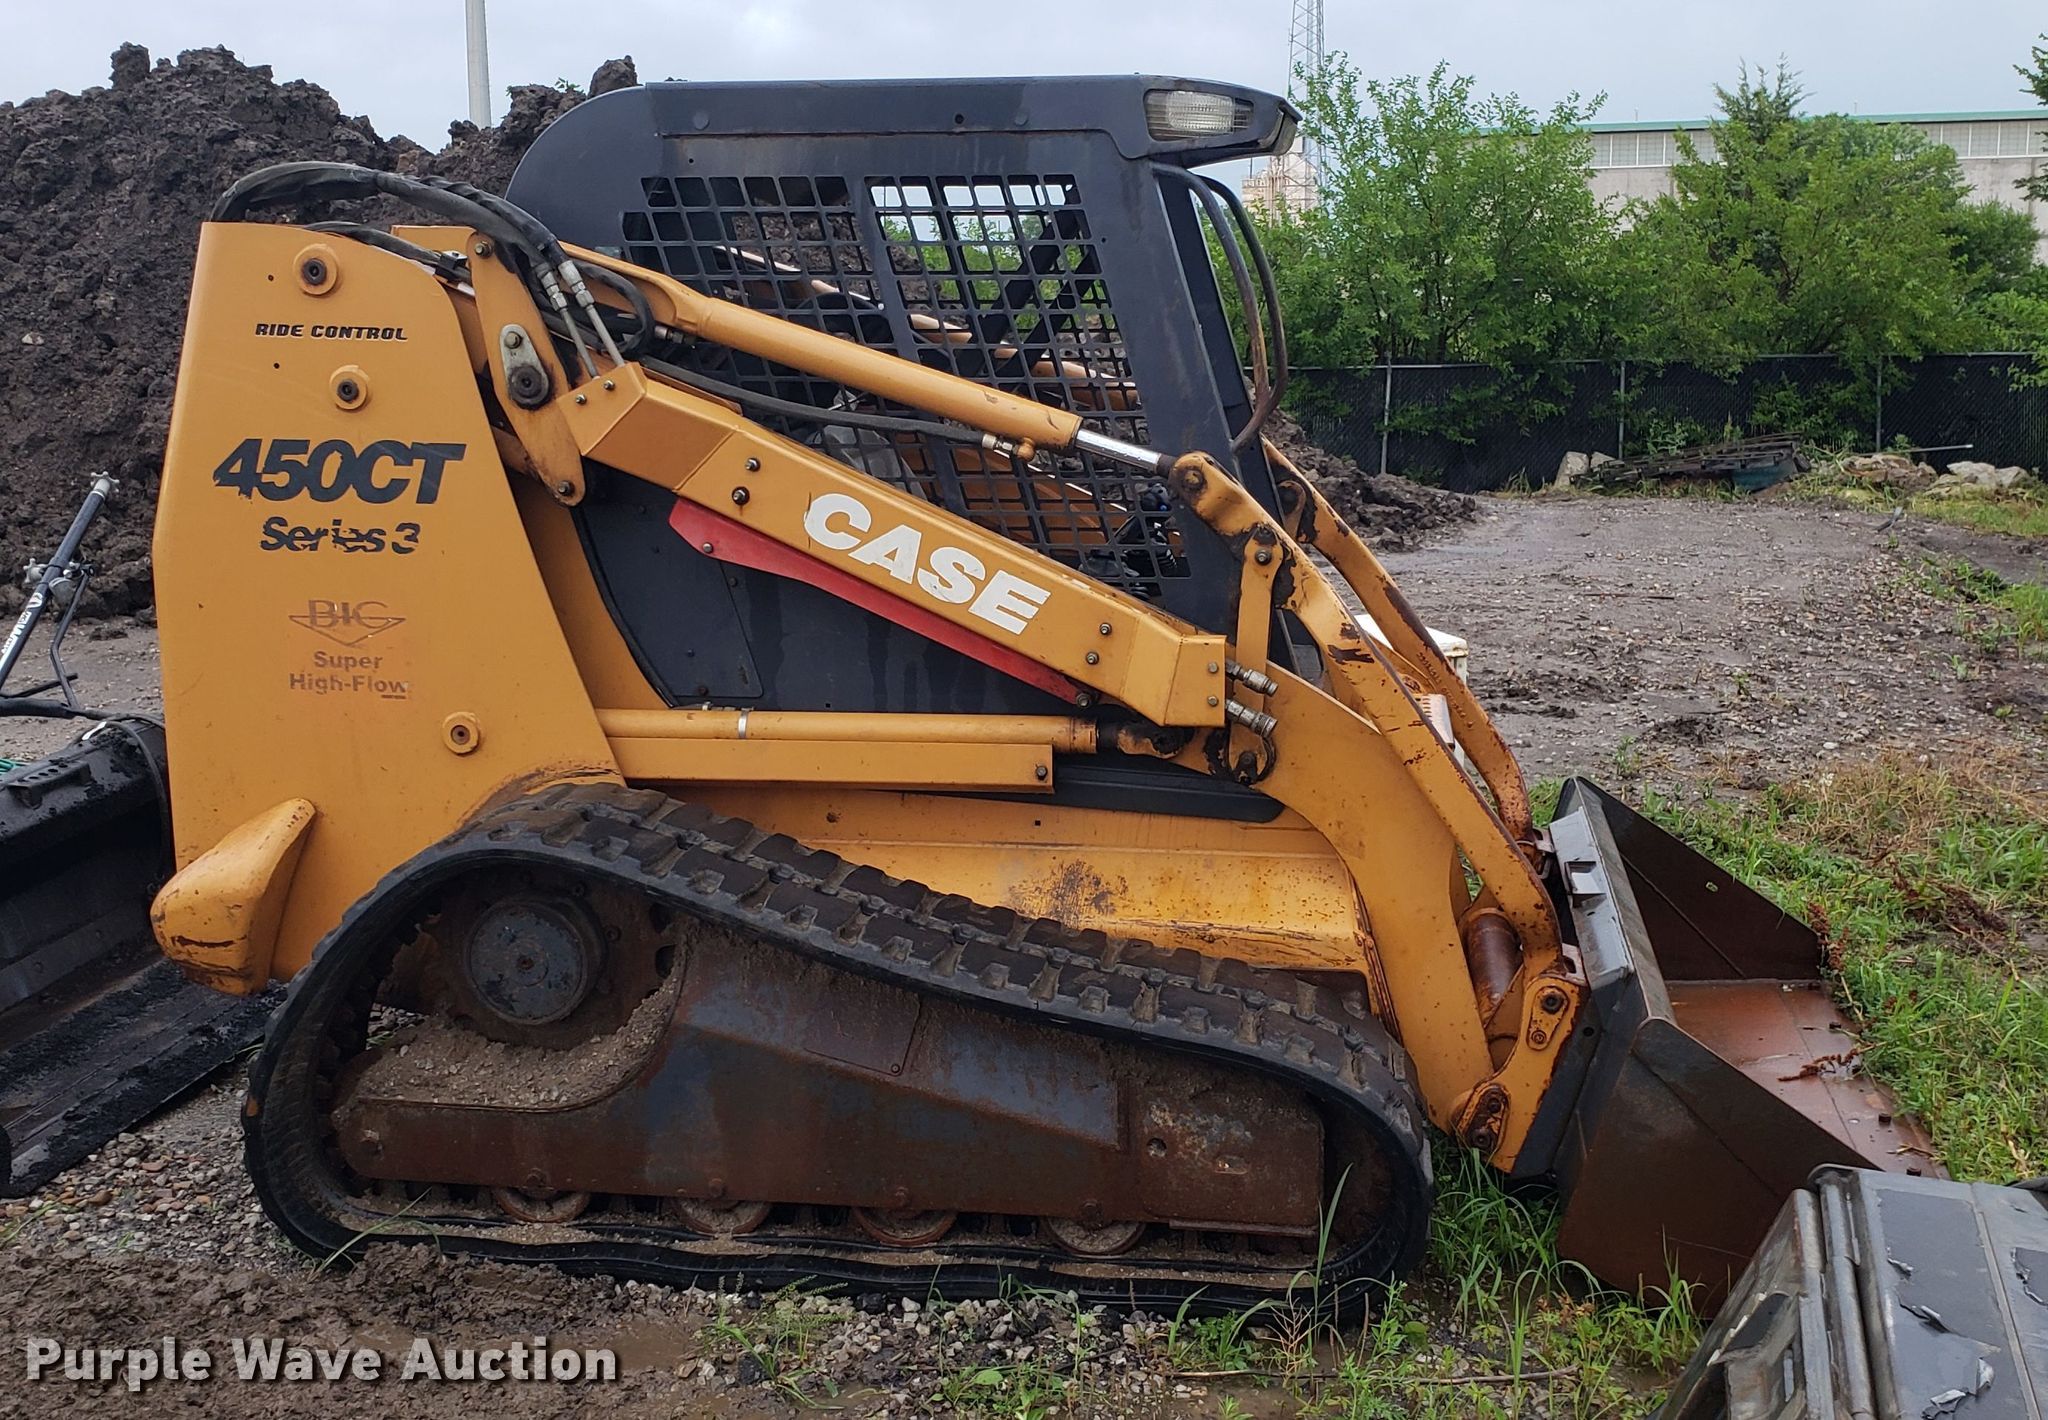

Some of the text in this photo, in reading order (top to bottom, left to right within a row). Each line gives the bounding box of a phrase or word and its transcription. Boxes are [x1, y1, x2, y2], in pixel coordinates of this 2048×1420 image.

[255, 323, 408, 341] RIDE CONTROL
[213, 438, 467, 504] 450CT
[260, 516, 421, 554] Series 3
[804, 493, 1051, 635] CASE
[314, 650, 383, 672] Super
[289, 673, 407, 695] High-Flow
